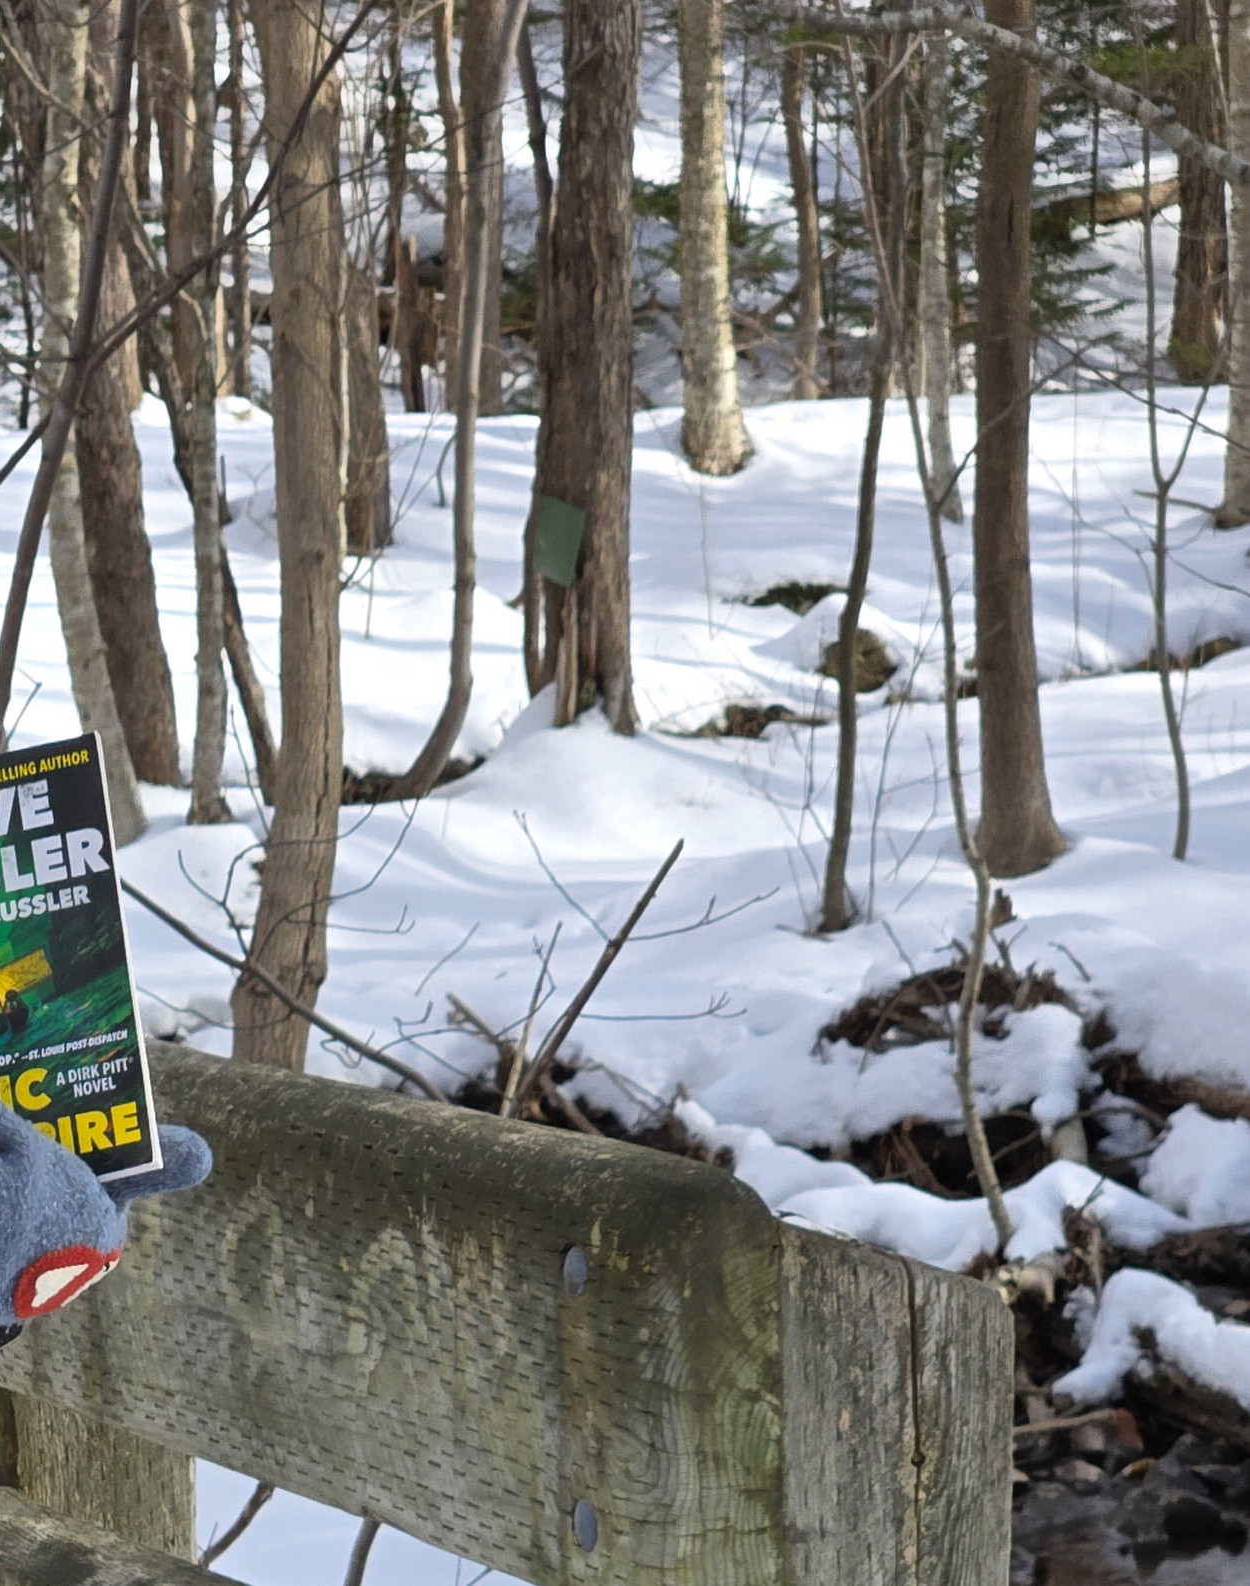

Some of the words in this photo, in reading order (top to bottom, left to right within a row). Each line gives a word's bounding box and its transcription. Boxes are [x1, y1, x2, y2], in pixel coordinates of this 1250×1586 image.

[39, 749, 90, 773] AUTHOR
[41, 1042, 65, 1058] LOUIS
[56, 1071, 66, 1086] A
[68, 1063, 100, 1083] DIRK
[73, 1076, 117, 1098] NOVEL
